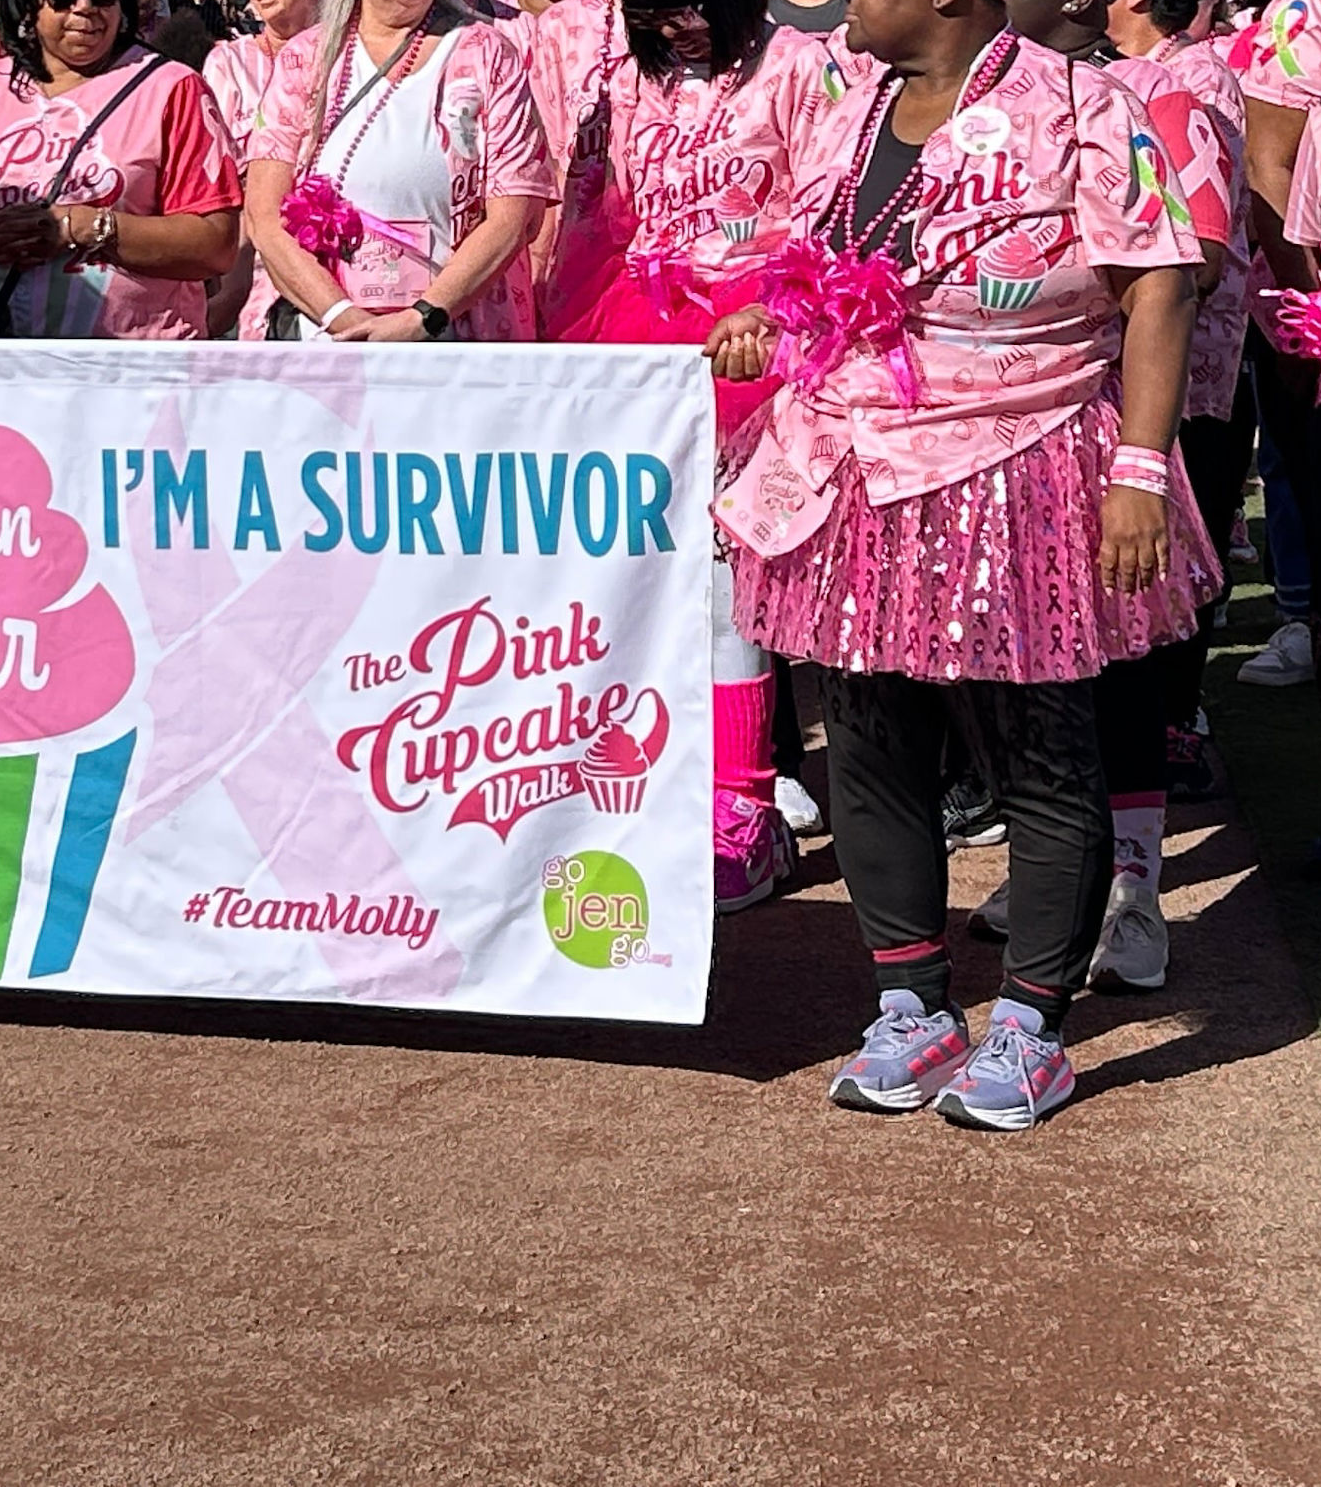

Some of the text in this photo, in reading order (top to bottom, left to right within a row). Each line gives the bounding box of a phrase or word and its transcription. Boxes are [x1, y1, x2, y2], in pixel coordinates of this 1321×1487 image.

[102, 449, 209, 549] I'M
[234, 451, 282, 551] A
[301, 451, 677, 558] SURVIVOR
[343, 596, 610, 713] The Pink
[337, 682, 636, 813] Cupcake
[478, 766, 573, 823] Walk
[542, 855, 586, 889] go
[183, 886, 440, 950] #TeamMolly
[554, 884, 646, 941] jen
[610, 933, 650, 969] go
